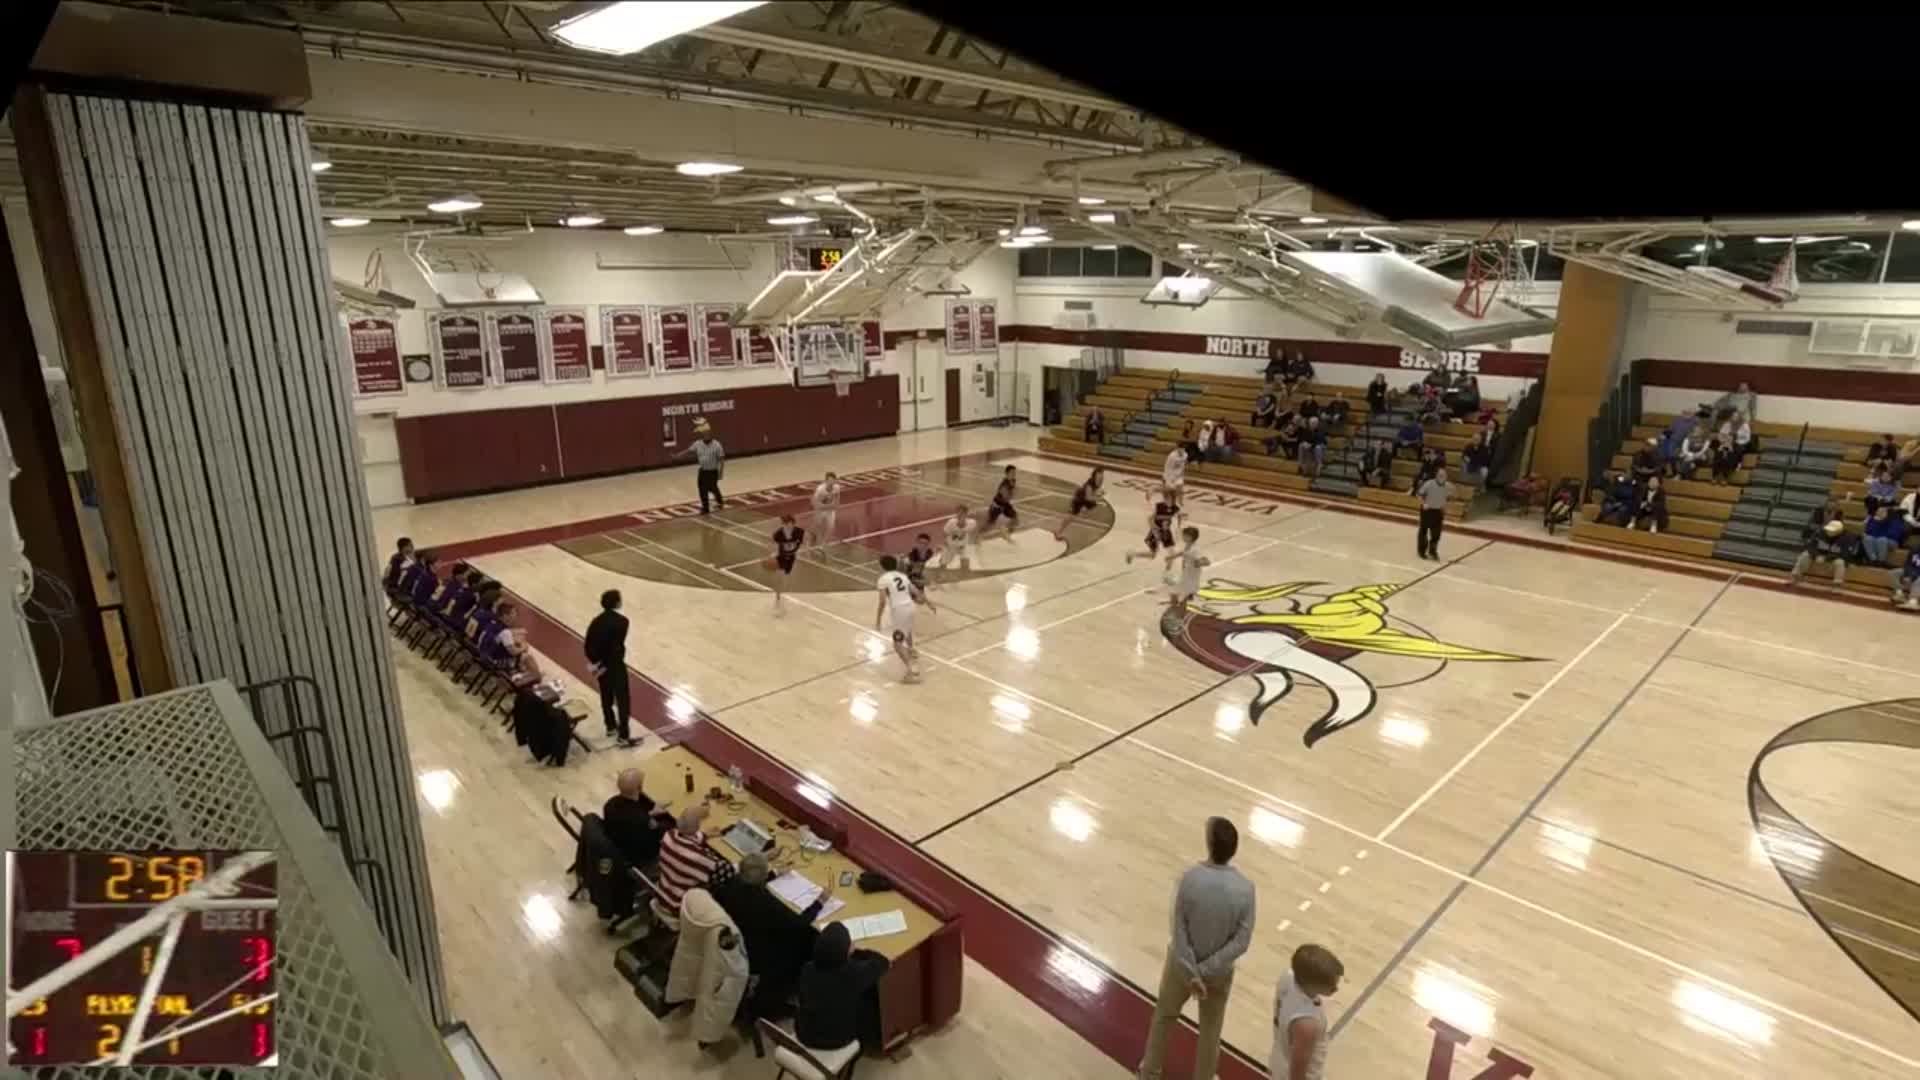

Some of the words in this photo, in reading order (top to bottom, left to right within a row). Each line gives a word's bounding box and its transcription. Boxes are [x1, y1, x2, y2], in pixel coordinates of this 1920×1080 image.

[1206, 336, 1270, 357] NORTH
[661, 403, 700, 417] NORTH
[630, 489, 793, 523] NOTH
[893, 576, 906, 593] 2
[106, 857, 205, 901] 2:58
[96, 1024, 121, 1057] 2
